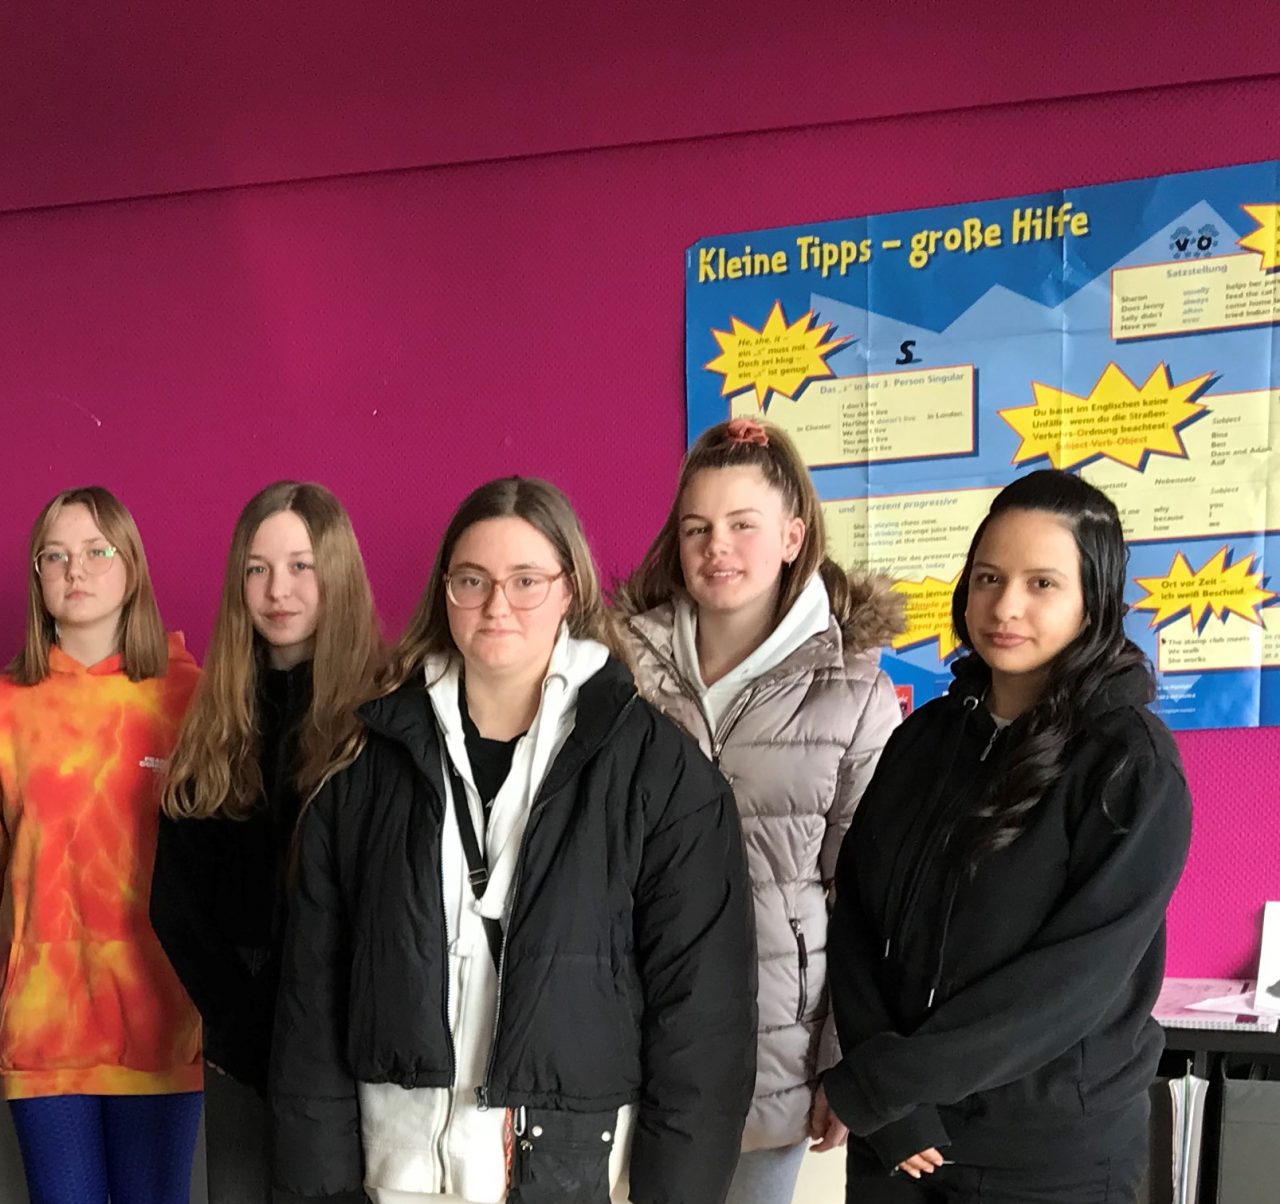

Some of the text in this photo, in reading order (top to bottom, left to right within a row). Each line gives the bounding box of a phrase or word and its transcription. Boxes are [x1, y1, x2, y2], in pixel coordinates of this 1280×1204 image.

[698, 246, 788, 283] Kleine
[797, 235, 872, 278] Tipps
[908, 217, 1002, 269] große
[1012, 202, 1089, 244] Hilfe
[1166, 263, 1229, 279] Satzstellung
[738, 359, 760, 368] Doch
[775, 355, 794, 366] klug
[820, 385, 837, 395] Das
[894, 376, 925, 387] Person
[927, 373, 965, 385] Singular
[1033, 408, 1047, 417] Du
[1076, 403, 1088, 413] im
[1091, 399, 1140, 413] Englischen
[1142, 398, 1169, 407] keine
[1069, 416, 1095, 427] wenn
[1097, 414, 1110, 424] du
[1111, 412, 1126, 422] die
[1161, 577, 1217, 589] Ort vor Zeit
[1160, 591, 1175, 600] ich
[1177, 590, 1200, 600] weiß
